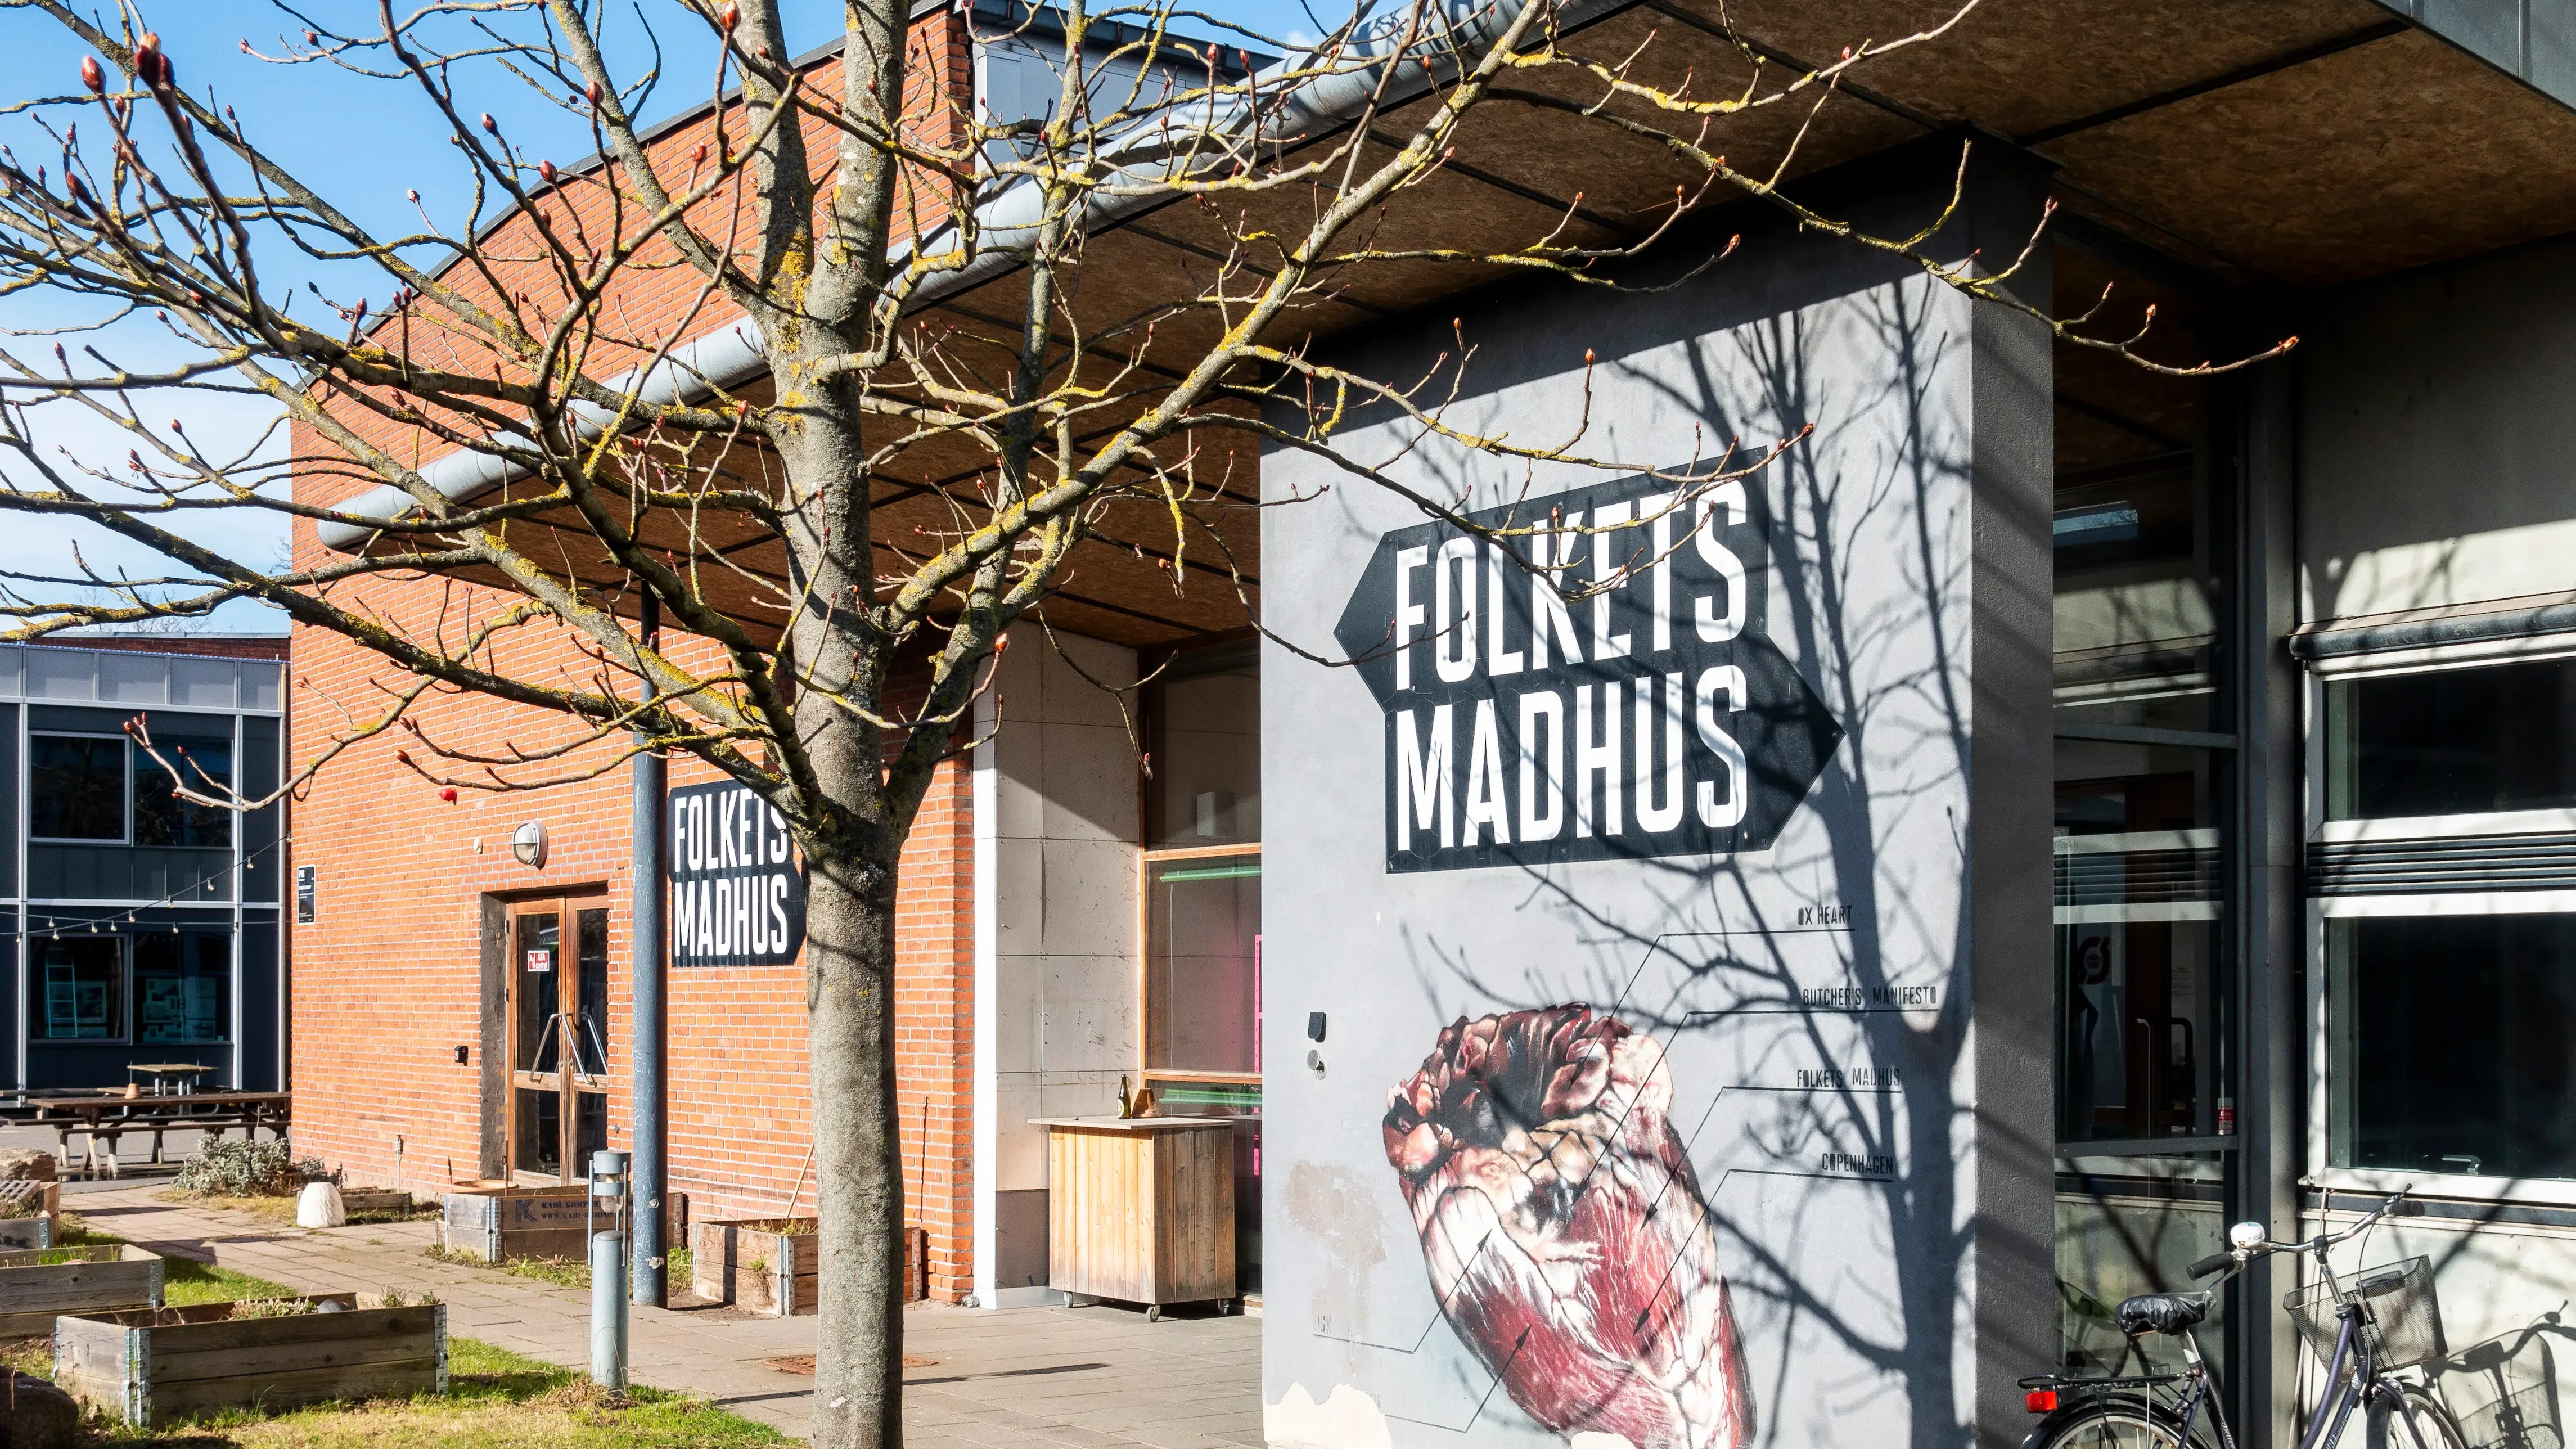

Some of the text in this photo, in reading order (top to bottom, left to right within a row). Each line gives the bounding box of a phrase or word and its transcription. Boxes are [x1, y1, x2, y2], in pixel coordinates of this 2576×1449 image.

[1395, 480, 1747, 691] FOLKETS
[1397, 665, 1748, 852] MADHUS
[674, 874, 787, 957] MADHUS
[1798, 904, 1852, 925] OX HEART
[1803, 986, 1936, 1006] BUTCHER'S MANIFESTO
[1797, 1067, 1901, 1088] FOLKETS MADHUS
[1822, 1153, 1893, 1174] COPENHAGEN
